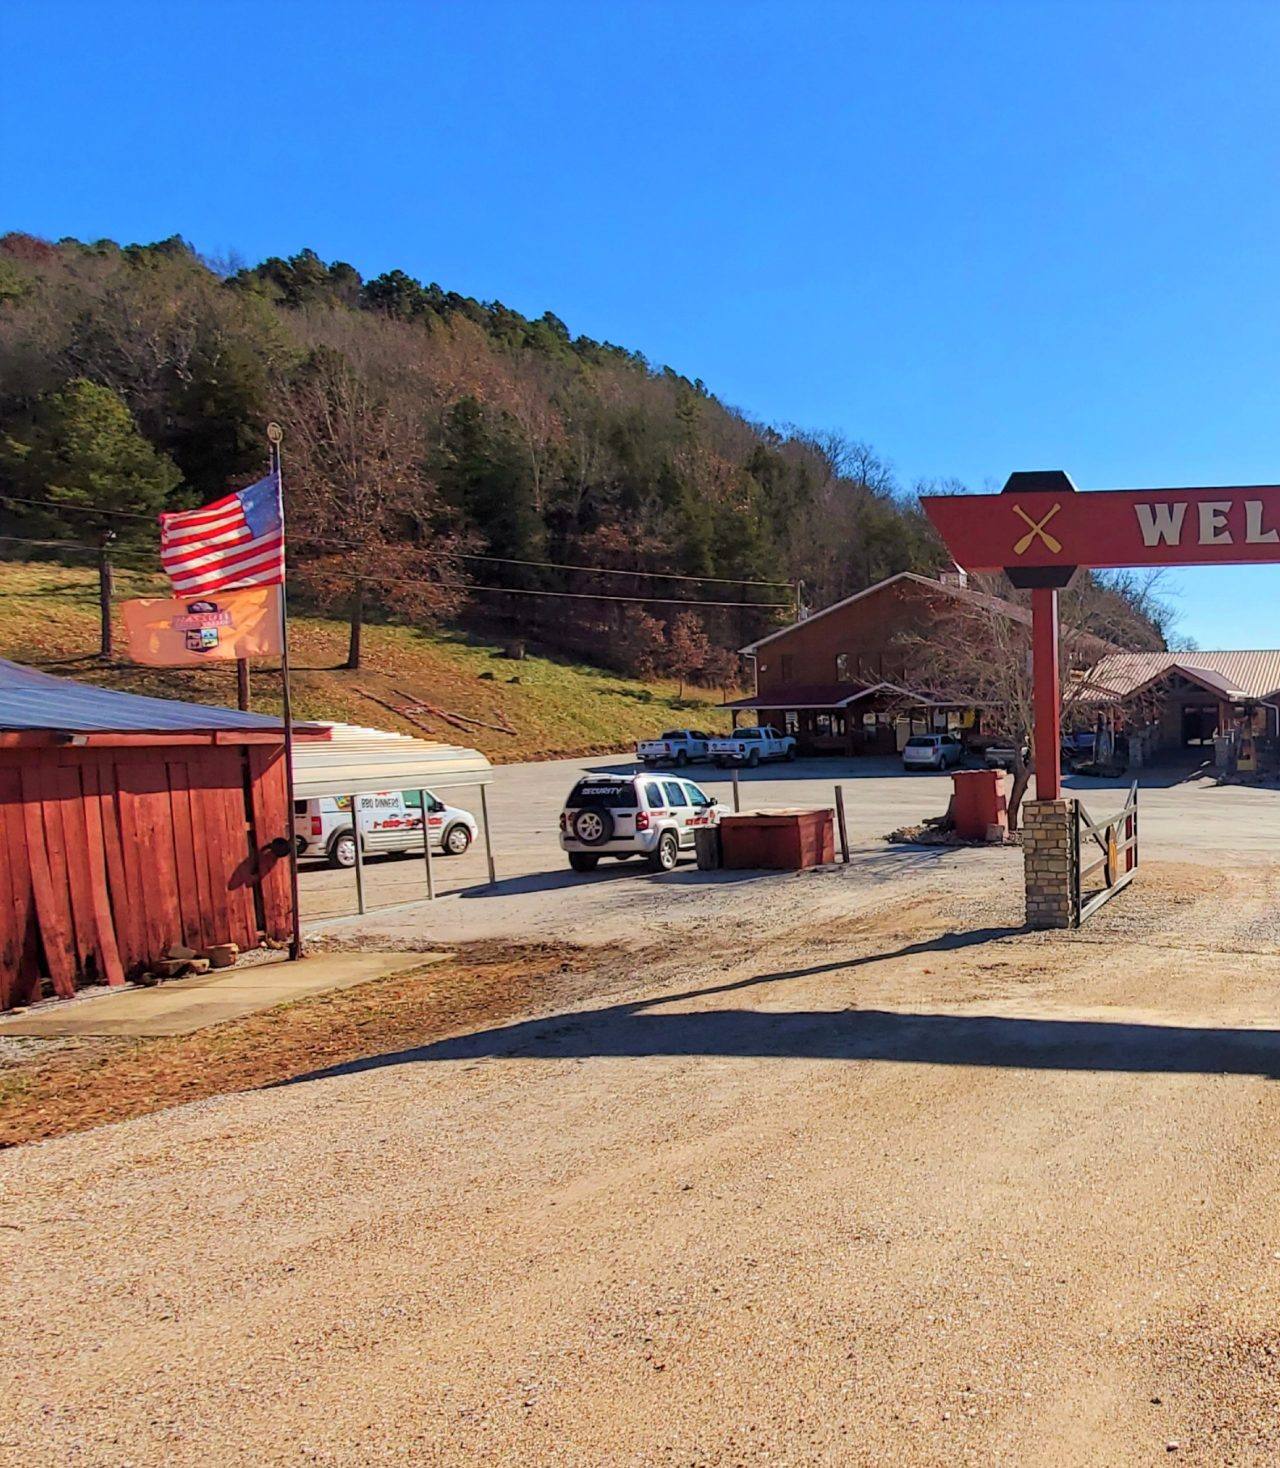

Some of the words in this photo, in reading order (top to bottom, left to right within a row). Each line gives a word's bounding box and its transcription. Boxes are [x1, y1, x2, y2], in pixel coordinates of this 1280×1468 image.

[581, 787, 623, 795] SECURITY
[361, 798, 374, 808] BBQ
[374, 798, 399, 808] DINNERS
